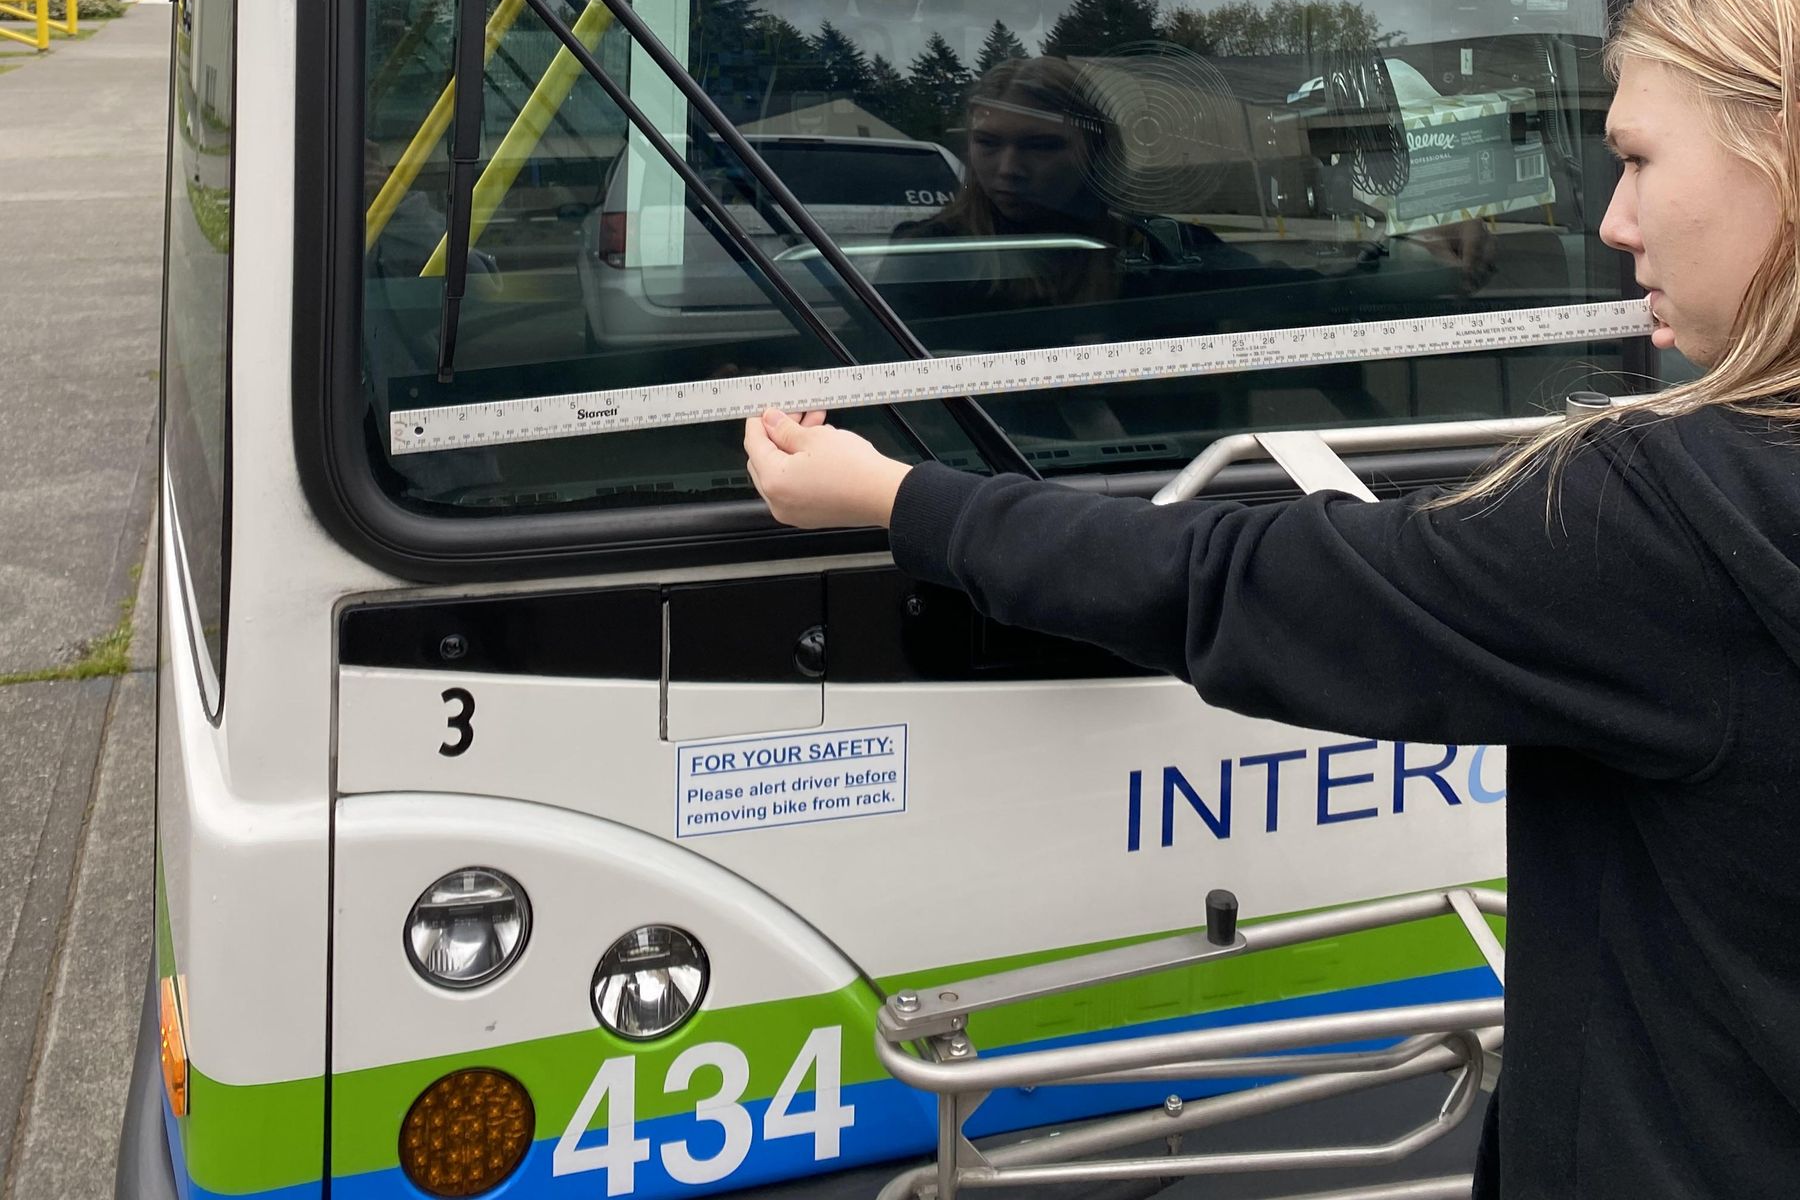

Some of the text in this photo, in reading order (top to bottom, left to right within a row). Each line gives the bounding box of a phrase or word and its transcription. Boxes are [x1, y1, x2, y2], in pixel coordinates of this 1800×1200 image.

[1406, 132, 1455, 151] leenex
[1410, 152, 1452, 165] ROFESSIONAL
[749, 383, 761, 391] 10
[819, 376, 830, 384] 12
[852, 373, 863, 381] 13
[885, 370, 896, 378] 14
[918, 366, 929, 374] 15
[951, 363, 962, 371] 16
[983, 360, 994, 368] 17
[1015, 358, 1026, 366] 18
[1047, 355, 1058, 363] 19
[1077, 352, 1089, 360] 20
[1108, 350, 1119, 358] 21
[1140, 347, 1152, 355] 22
[1171, 344, 1183, 352] 23
[1201, 342, 1213, 350] 24
[1263, 337, 1275, 345] 26
[1293, 334, 1305, 342] 27
[1323, 332, 1335, 340] 28
[1353, 329, 1365, 337] 29
[1383, 327, 1395, 335] 30
[1442, 322, 1454, 330] 32
[1472, 319, 1484, 327] 33
[1501, 317, 1512, 325] 34
[1529, 315, 1541, 323] 35
[1558, 312, 1570, 320] 36
[1586, 310, 1598, 318] 37
[1614, 307, 1625, 315] 38
[577, 408, 618, 420] Starrett
[438, 687, 476, 758] 3
[691, 737, 895, 774] FOR YOUR SAFETY:
[687, 768, 897, 803] Please alert driver before
[687, 790, 895, 825] removing bike from rack.
[552, 1024, 855, 1197] 434
